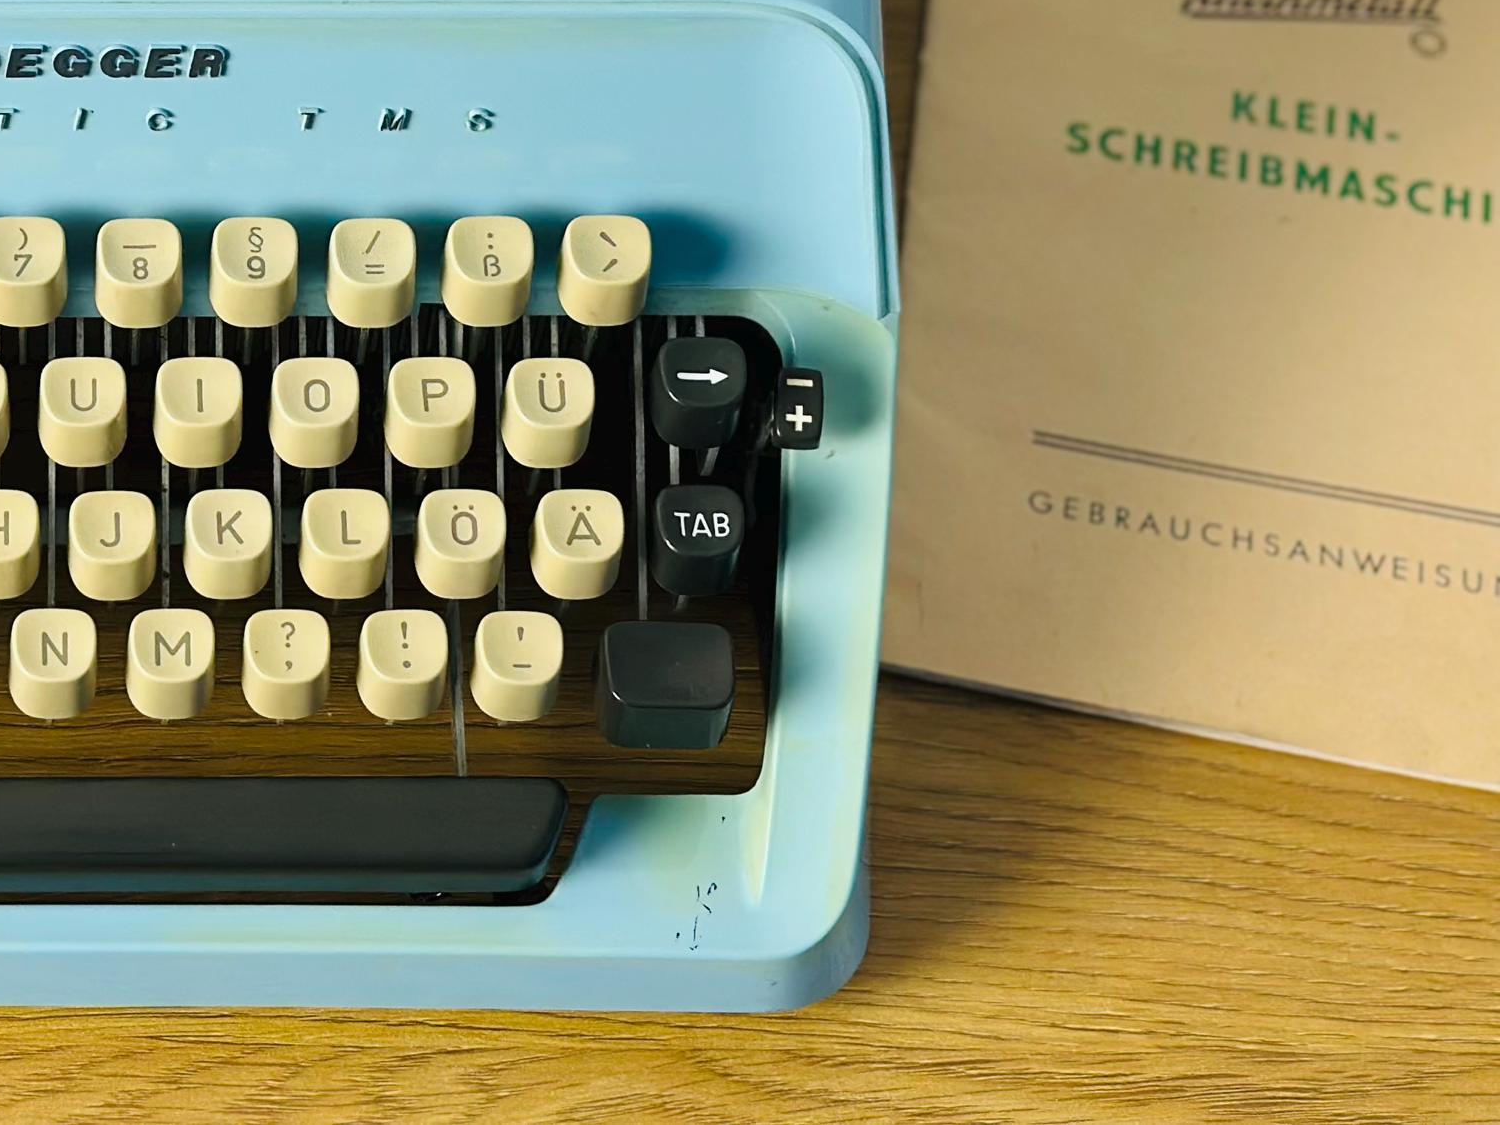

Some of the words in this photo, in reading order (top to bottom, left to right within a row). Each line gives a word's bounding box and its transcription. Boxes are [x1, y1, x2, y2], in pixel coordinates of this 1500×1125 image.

[1230, 90, 1402, 144] KLEIN-
[1066, 122, 1493, 224] SCHREIBMASCHI
[18, 227, 29, 251] )
[248, 226, 264, 254] §
[13, 253, 33, 278] 7
[132, 256, 149, 281] 8
[246, 255, 266, 280] 9
[69, 378, 97, 412] U
[196, 378, 204, 413] I
[303, 378, 331, 413] O
[421, 378, 449, 413] P
[538, 372, 566, 413] Ü
[99, 511, 121, 548] J
[215, 510, 244, 546] K
[340, 509, 362, 546] L
[450, 504, 478, 546] Ö
[565, 505, 602, 547] Ä
[672, 509, 732, 539] TAB
[41, 631, 69, 667] N
[154, 630, 192, 667] M
[280, 621, 296, 649] ?
[400, 621, 409, 650] !
